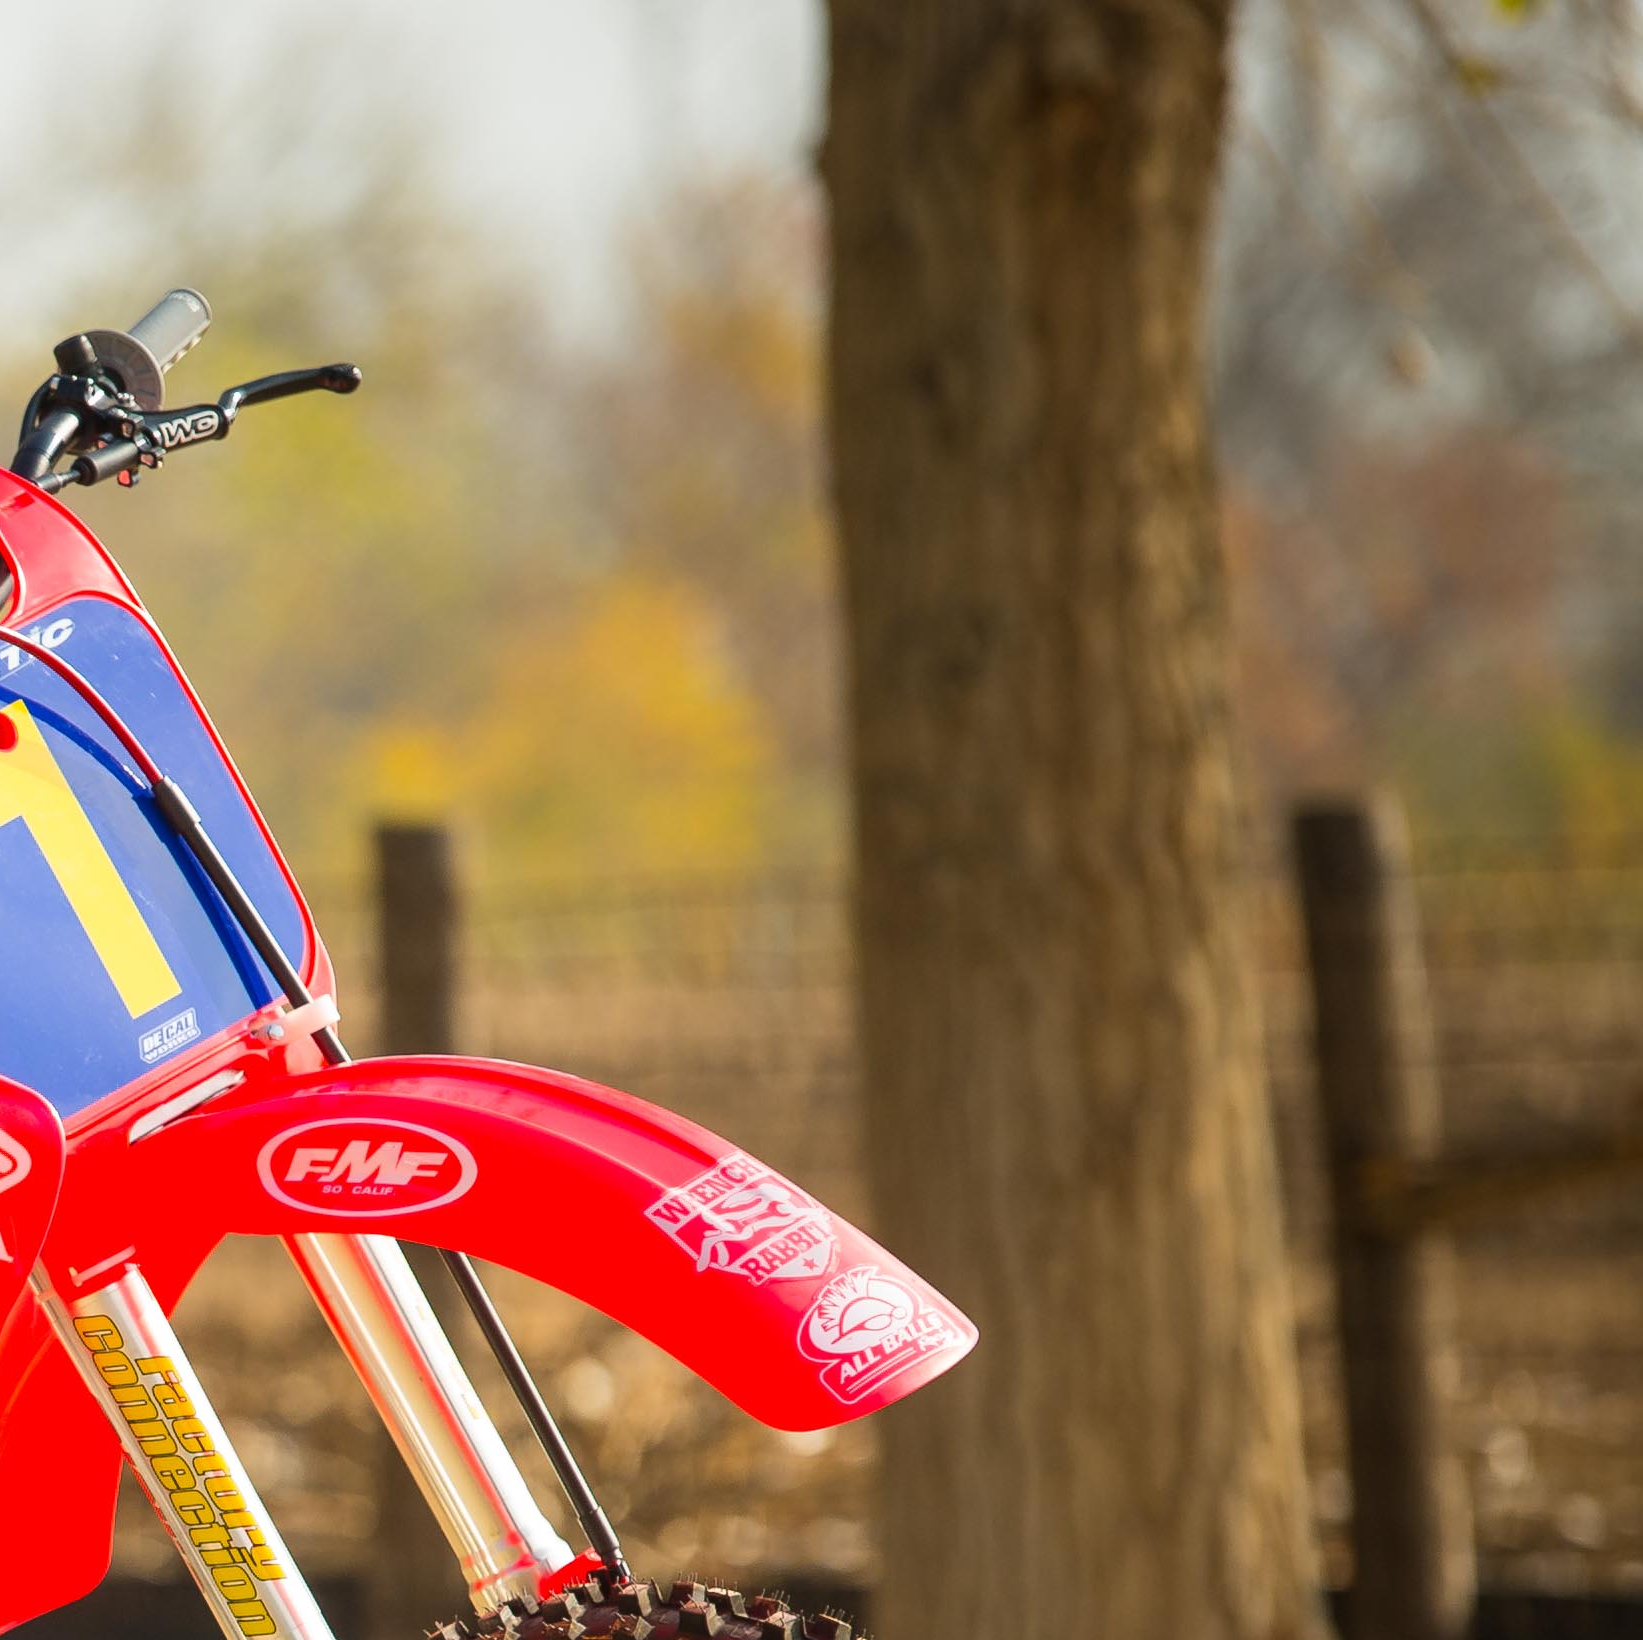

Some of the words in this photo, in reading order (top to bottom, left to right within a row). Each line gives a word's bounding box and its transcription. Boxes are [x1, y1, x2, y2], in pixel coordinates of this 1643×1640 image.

[284, 1140, 448, 1185] FMF
[652, 1156, 764, 1226] WRENCH
[739, 1218, 832, 1284] RABBIT
[840, 1345, 881, 1384] ALL
[881, 1312, 943, 1352] BALLS
[135, 1356, 288, 1581] Factory
